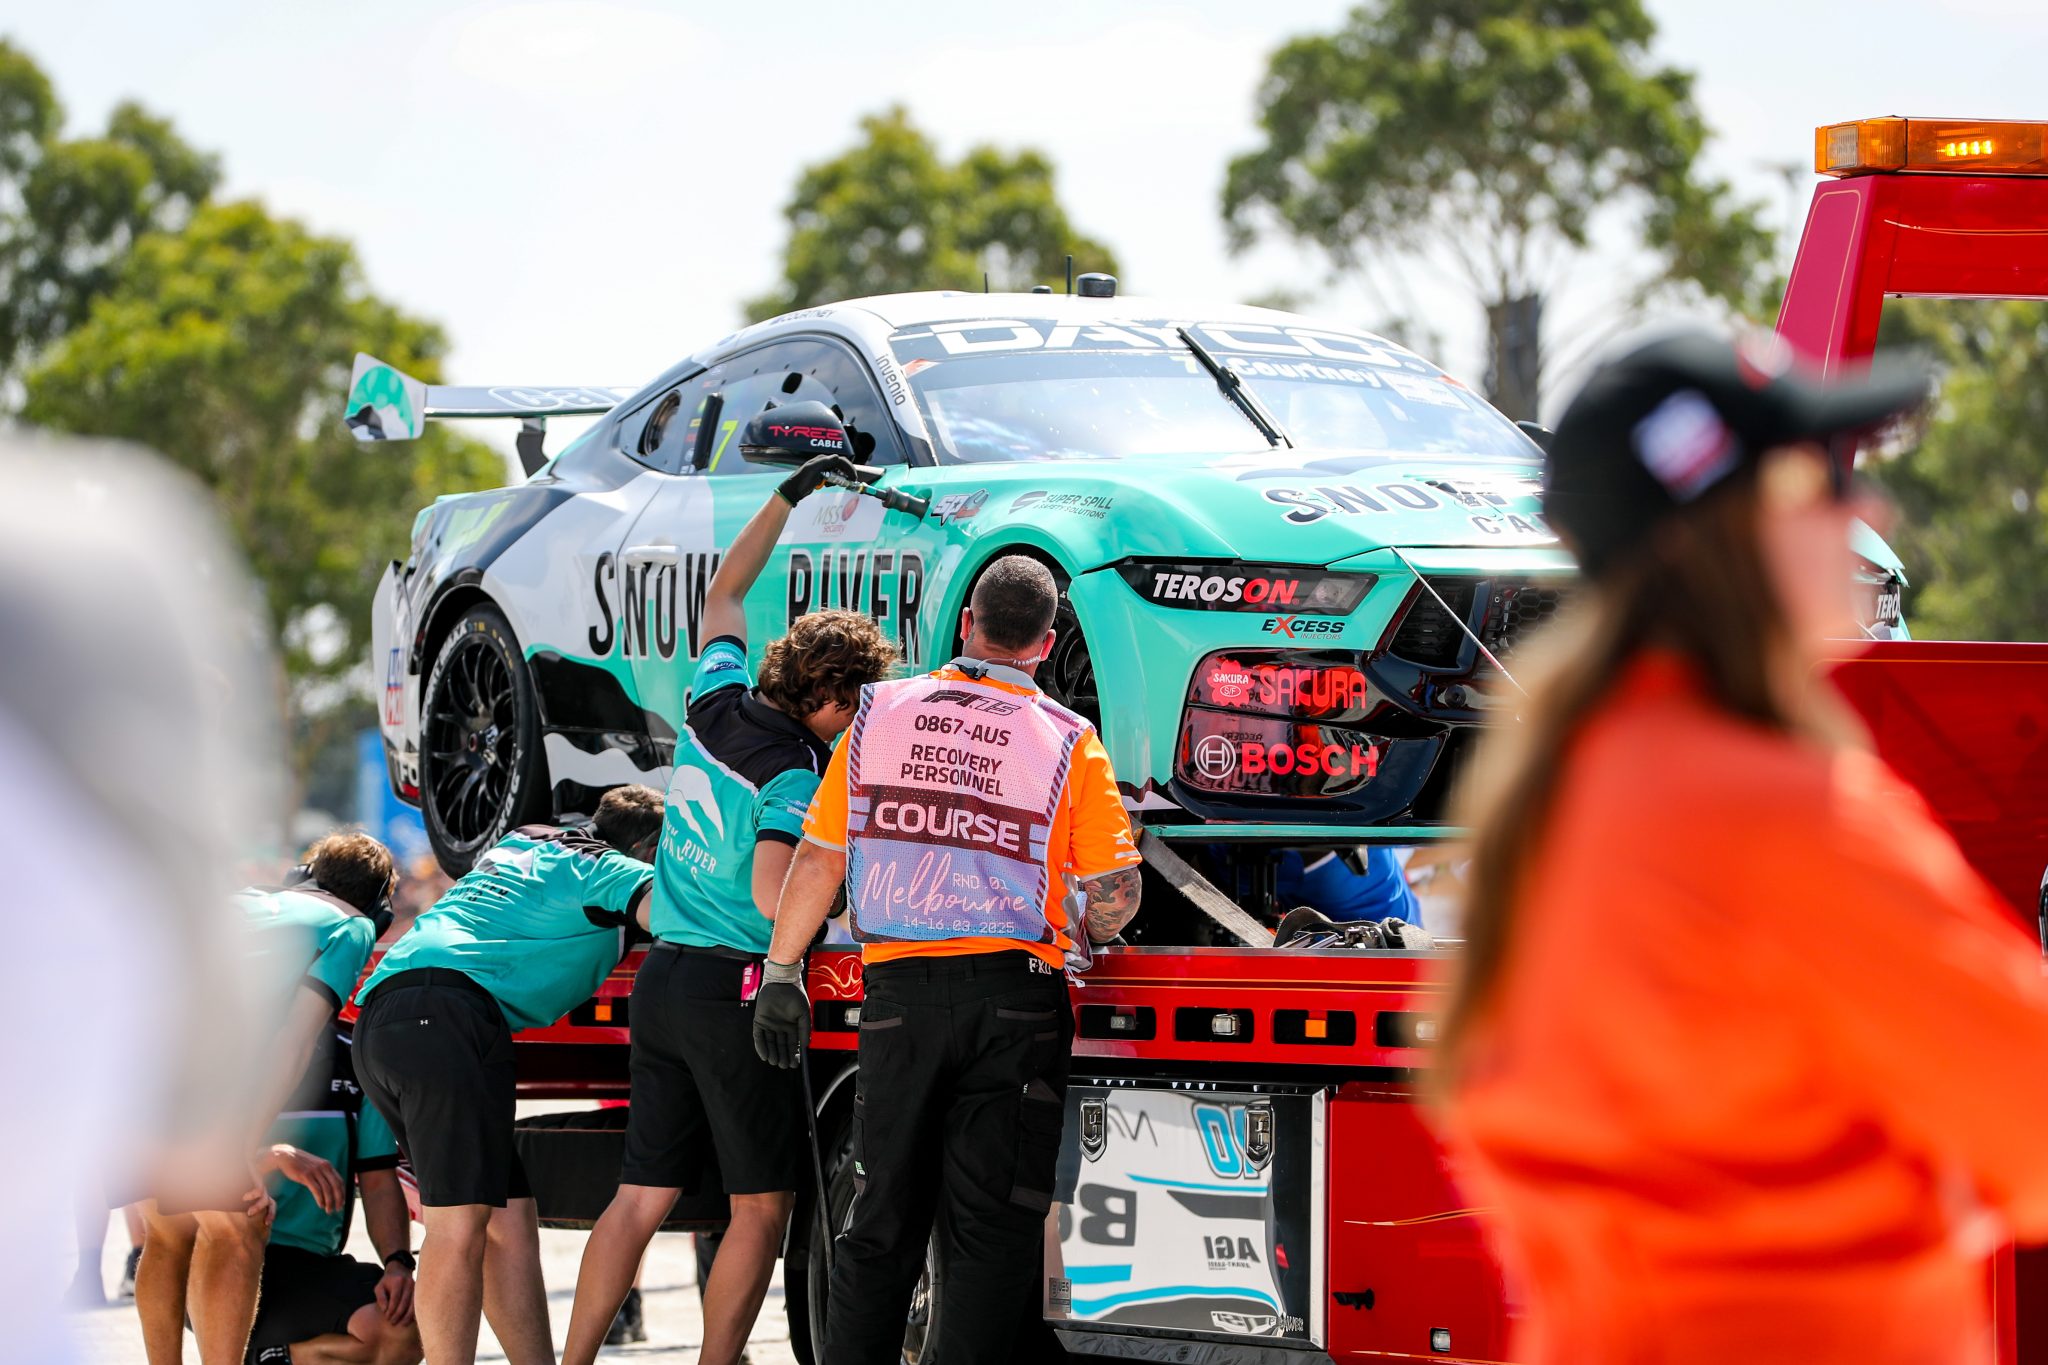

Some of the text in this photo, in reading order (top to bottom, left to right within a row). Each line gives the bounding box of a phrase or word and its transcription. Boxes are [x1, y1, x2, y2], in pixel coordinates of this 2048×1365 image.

[895, 318, 1408, 368] DAYCO
[876, 353, 906, 406] invenio
[1226, 357, 1382, 388] Courtney
[708, 420, 739, 473] 7
[768, 425, 843, 441] TYREE
[810, 438, 843, 449] CABLE
[1046, 494, 1114, 510] SUPER SPILL
[1064, 506, 1107, 520] SOLUTIONS
[1152, 573, 1300, 606] TEROSON
[785, 549, 926, 668] RIVER
[1261, 615, 1346, 639] EXCESS
[1299, 632, 1343, 641] INJECTORS
[1213, 672, 1250, 685] SAKURA
[1259, 667, 1367, 710] SAKURA
[914, 714, 1012, 747] 0867-AUS
[910, 744, 1003, 776] RECOVERY
[1241, 743, 1378, 778] BOSCH
[900, 763, 1004, 798] PERSONNEL
[874, 800, 1021, 853] COURSE
[681, 838, 717, 874] RIVER
[860, 851, 1030, 921] Melbourne
